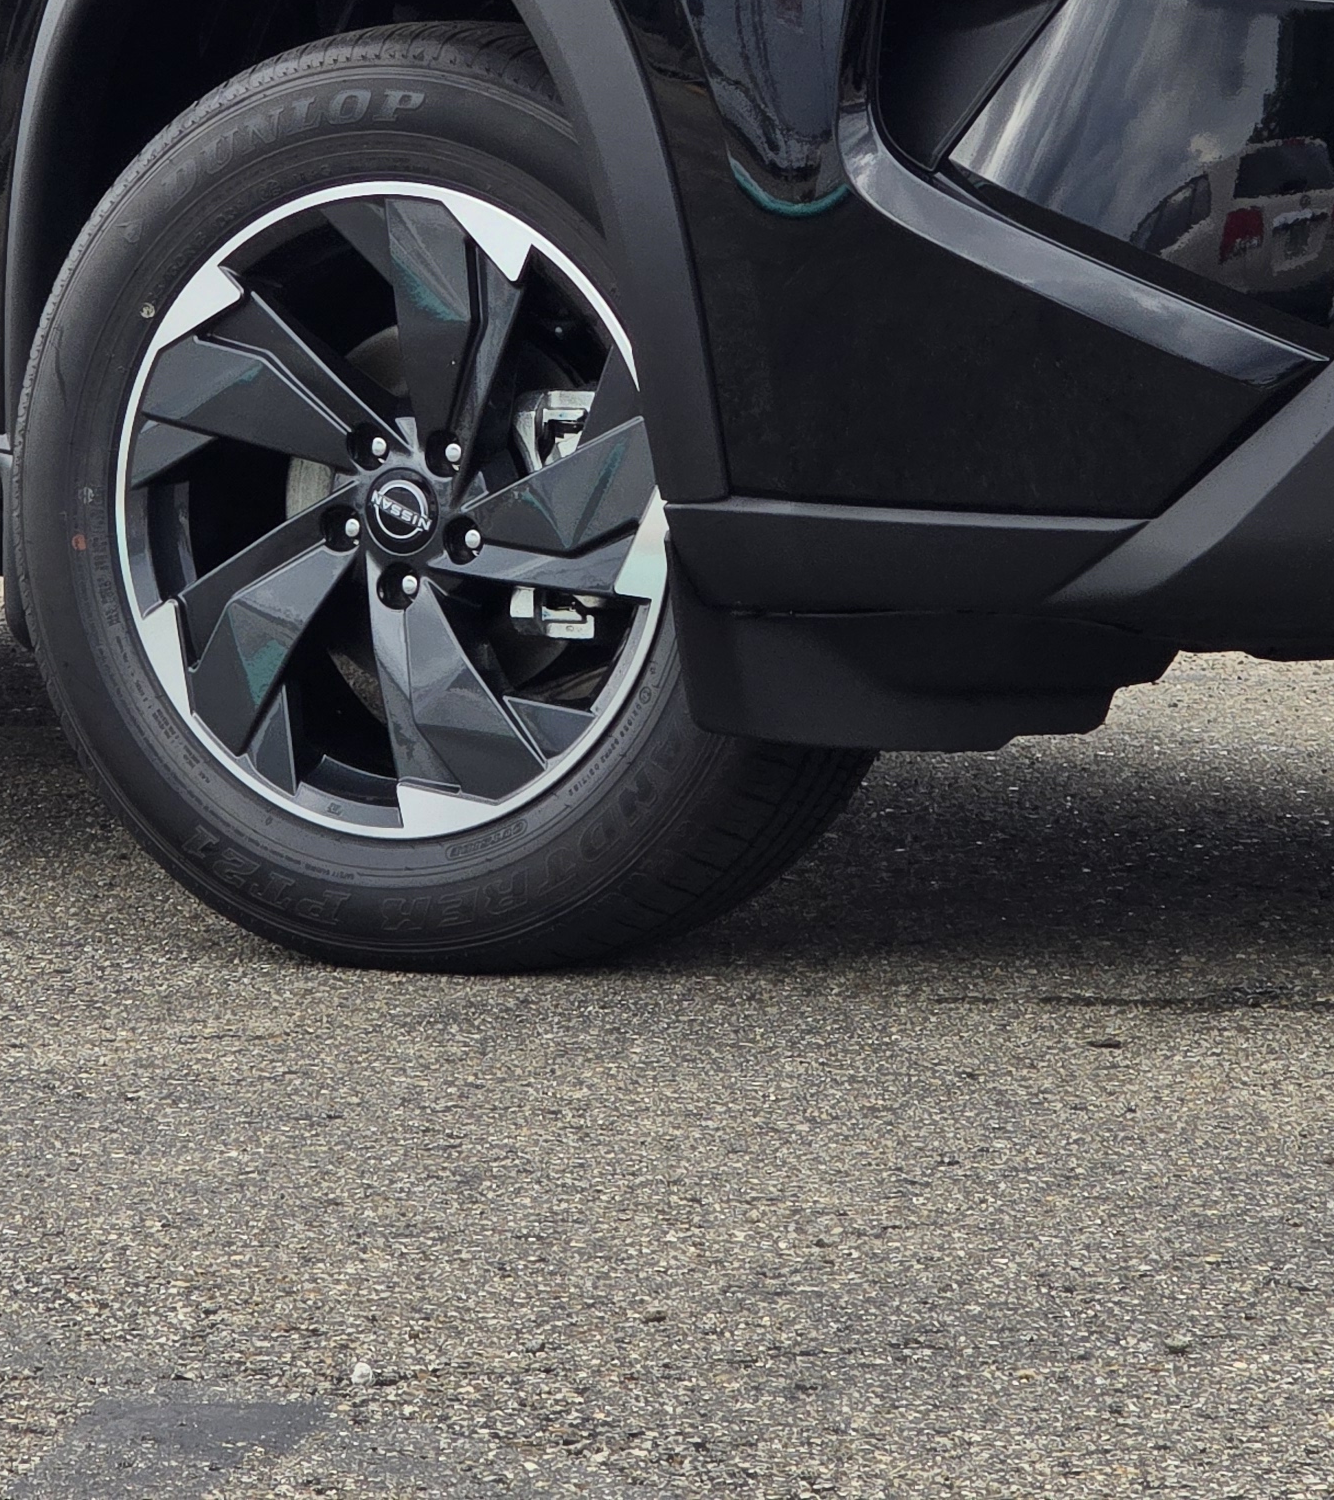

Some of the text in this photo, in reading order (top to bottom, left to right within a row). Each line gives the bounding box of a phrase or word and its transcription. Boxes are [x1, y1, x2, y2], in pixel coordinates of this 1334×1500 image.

[160, 88, 426, 197] DUNLOP
[371, 489, 433, 531] NISSAN
[179, 820, 350, 926] PT21
